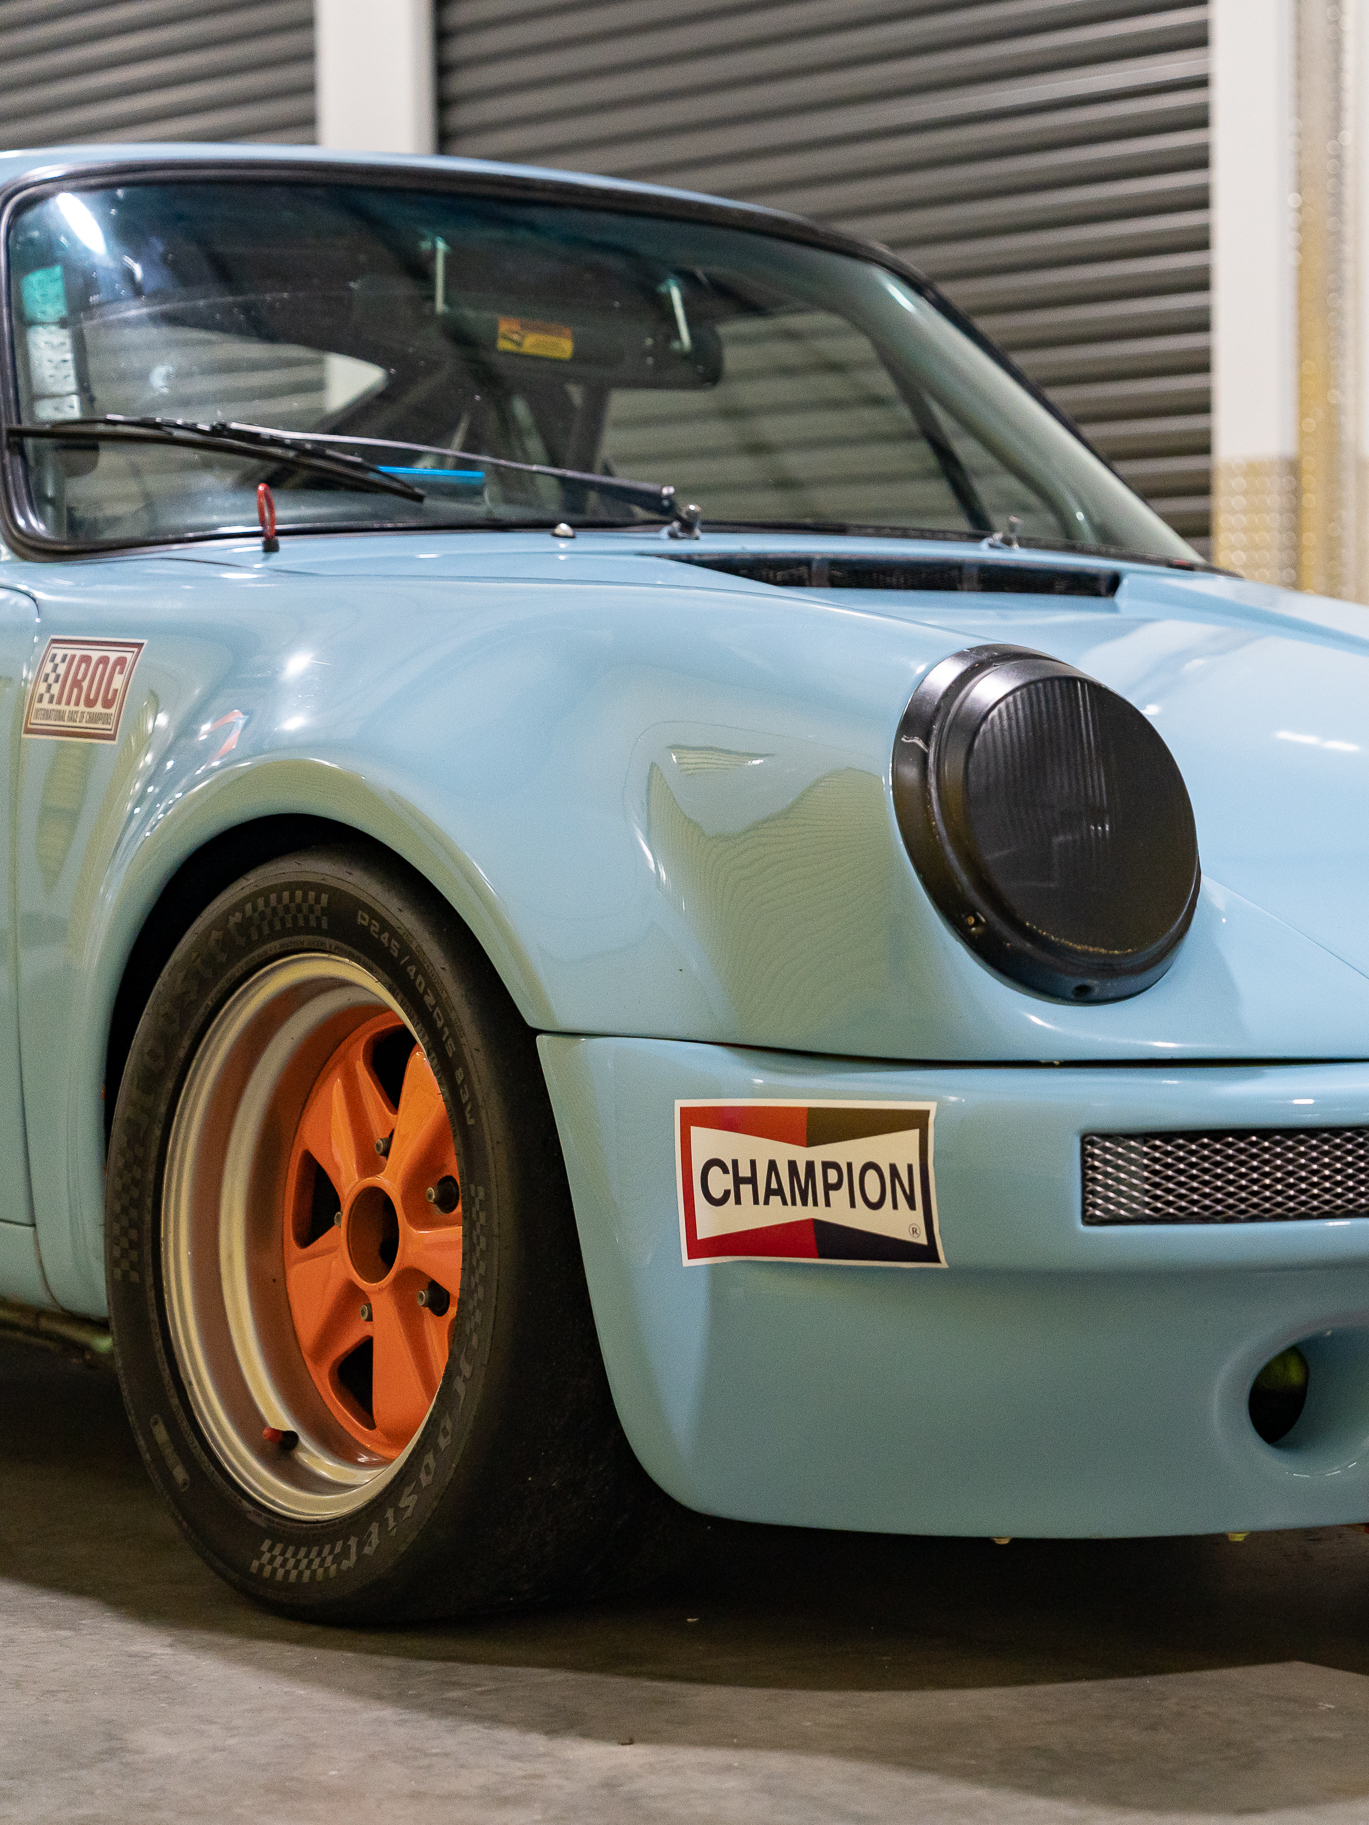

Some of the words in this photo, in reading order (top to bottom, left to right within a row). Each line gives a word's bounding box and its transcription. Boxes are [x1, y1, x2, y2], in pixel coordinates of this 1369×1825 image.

[56, 654, 127, 709] IROC
[357, 910, 456, 1058] P245/40ZR15
[700, 1157, 917, 1212] CHAMPION
